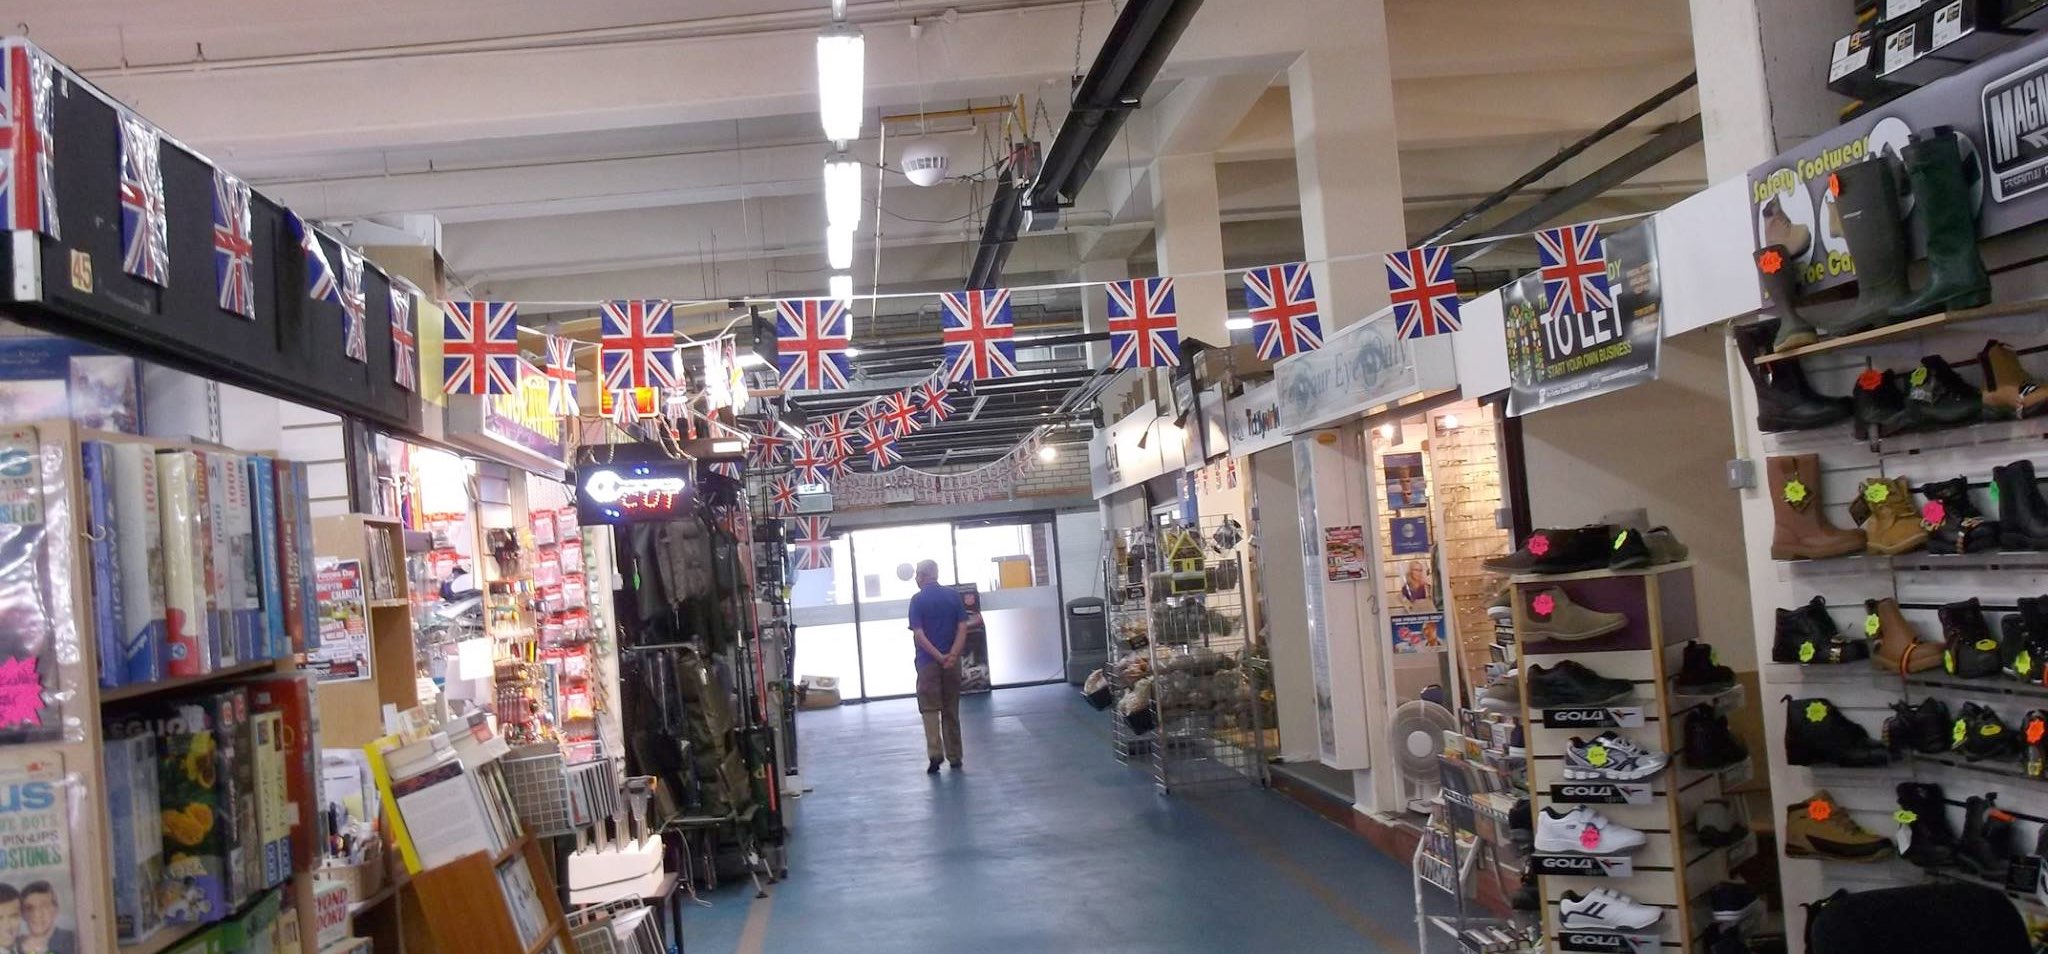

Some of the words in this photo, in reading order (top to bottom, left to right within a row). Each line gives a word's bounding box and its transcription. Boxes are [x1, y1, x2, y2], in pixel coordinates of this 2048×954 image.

[1754, 170, 1795, 203] Safety
[1797, 135, 1870, 184] Footwear
[72, 255, 91, 290] 45
[1540, 312, 1574, 360] TO
[1577, 283, 1623, 349] LET
[1566, 354, 1584, 373] YOUR
[1583, 350, 1600, 368] OWN
[1599, 339, 1633, 363] BUSINESS
[1554, 710, 1604, 722] GOLA
[1561, 786, 1612, 797] GOLA
[1542, 857, 1593, 869] GOLA
[1569, 935, 1620, 946] GOLA
